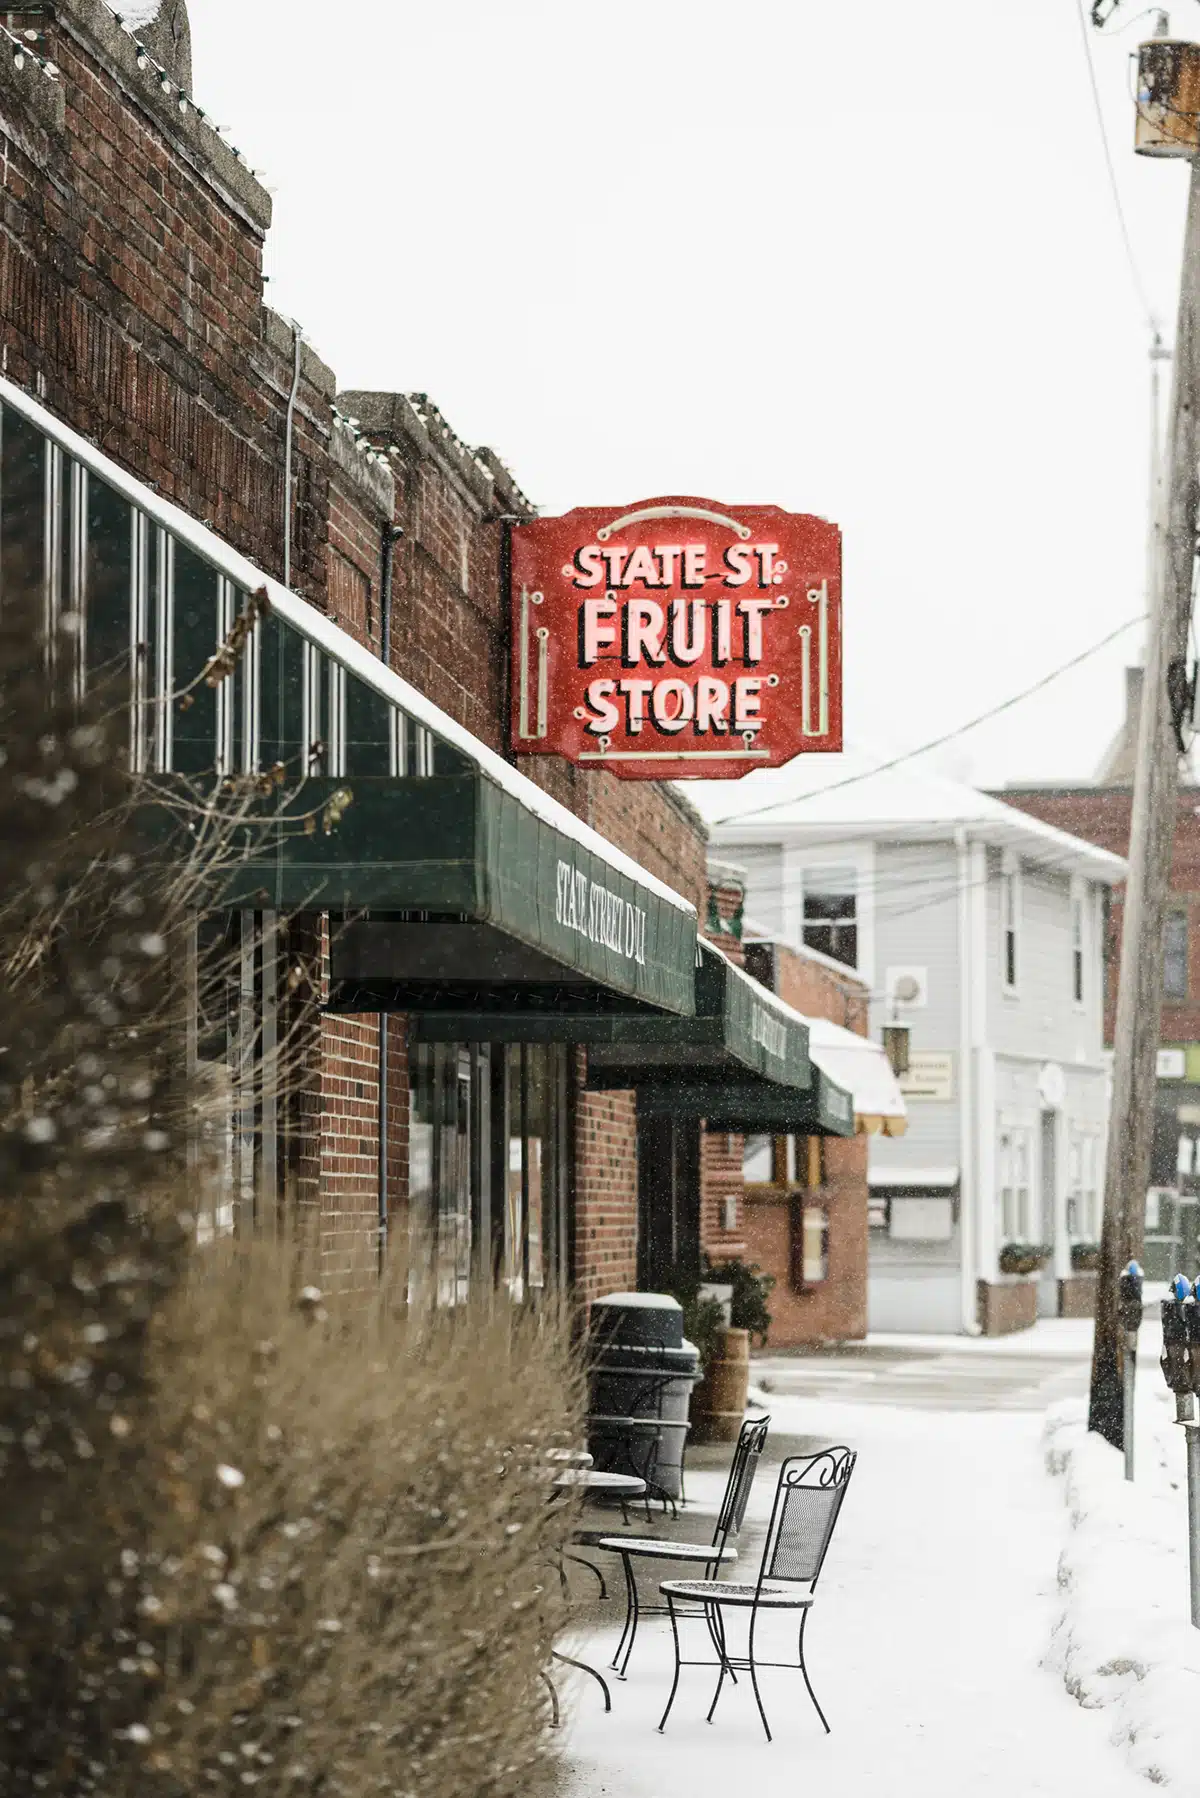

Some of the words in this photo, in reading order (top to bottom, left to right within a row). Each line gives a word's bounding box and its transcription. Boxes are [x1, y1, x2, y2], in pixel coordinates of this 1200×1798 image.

[574, 543, 707, 588] STATE
[722, 543, 783, 588] ST.
[578, 598, 772, 667] FRUIT
[584, 676, 765, 735] STORE
[556, 859, 587, 936] STATE
[589, 881, 624, 954] STREET
